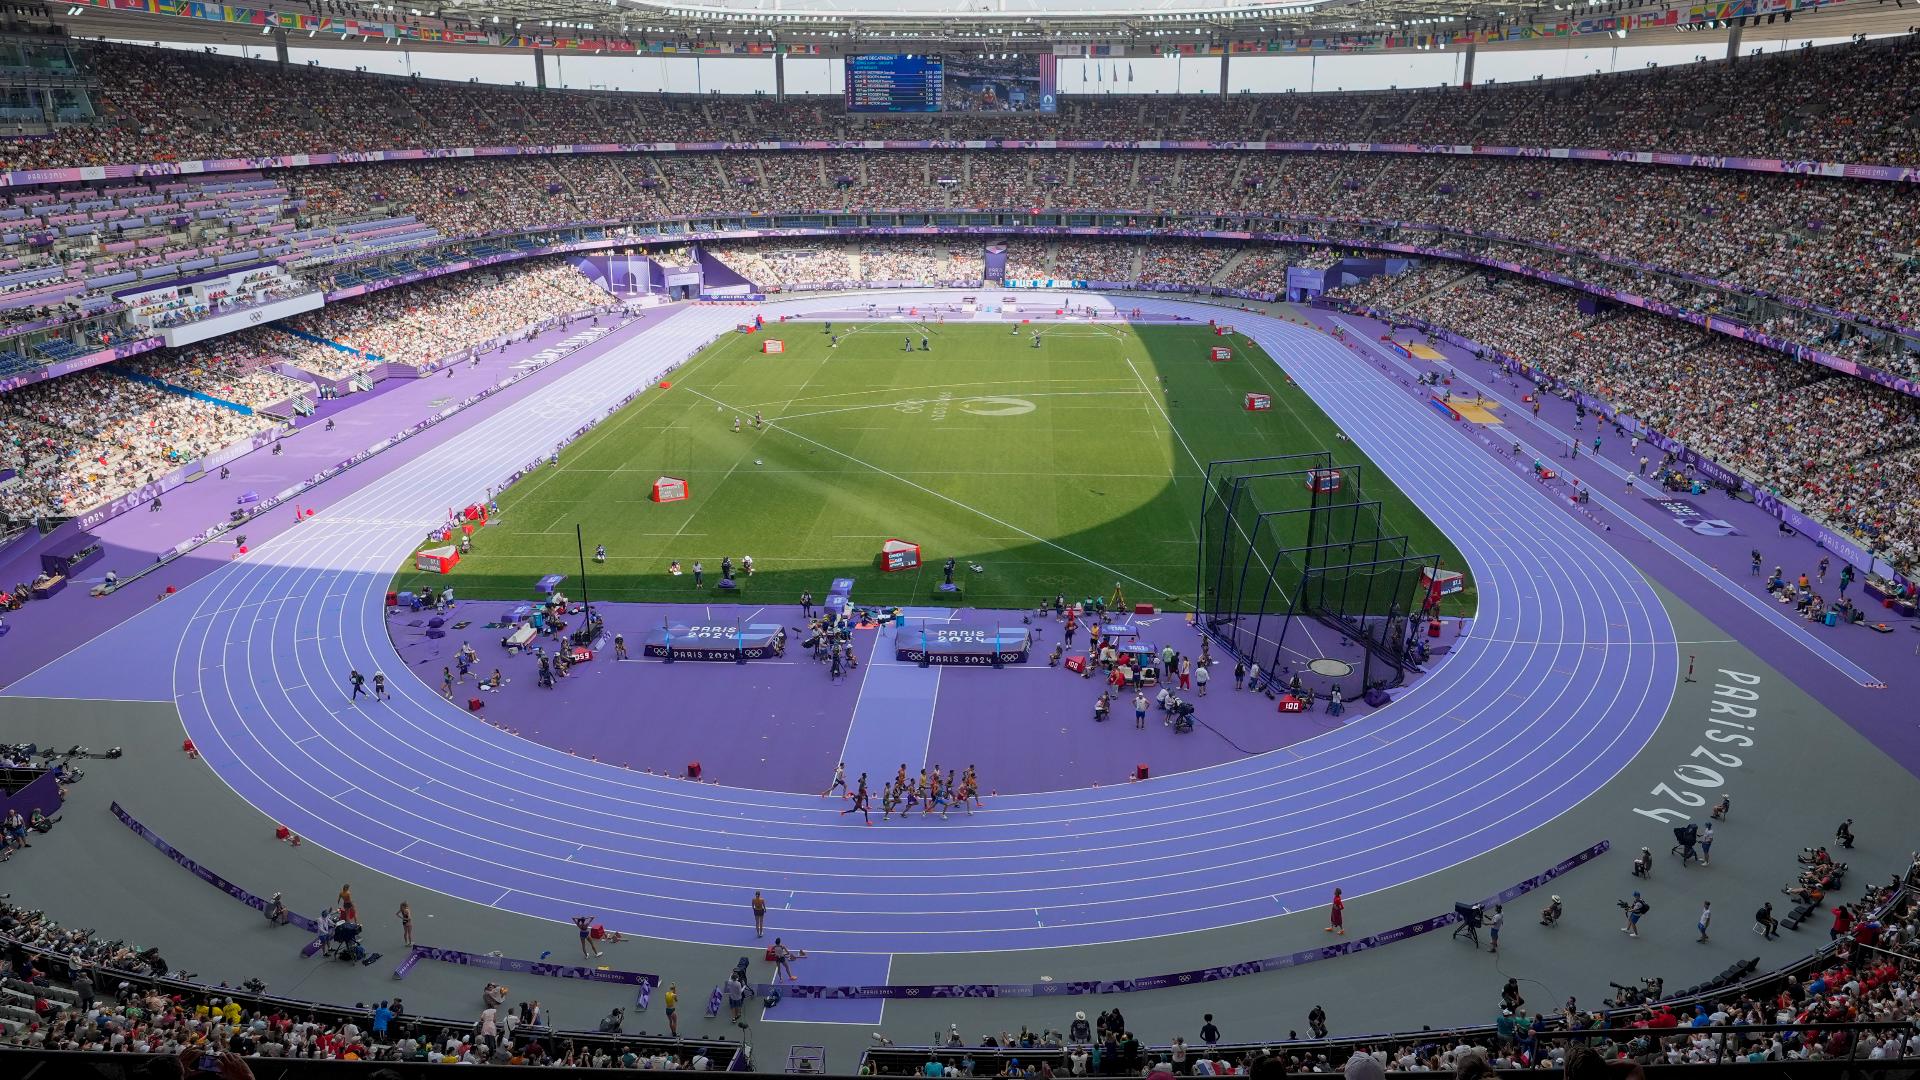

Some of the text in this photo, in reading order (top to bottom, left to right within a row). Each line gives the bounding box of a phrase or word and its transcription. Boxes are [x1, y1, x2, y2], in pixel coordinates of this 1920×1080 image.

[1703, 462, 1734, 484] PARIS 2024
[83, 512, 104, 526] 2024
[1819, 531, 1860, 562] PARIS 2024
[632, 744, 743, 824] 2024
